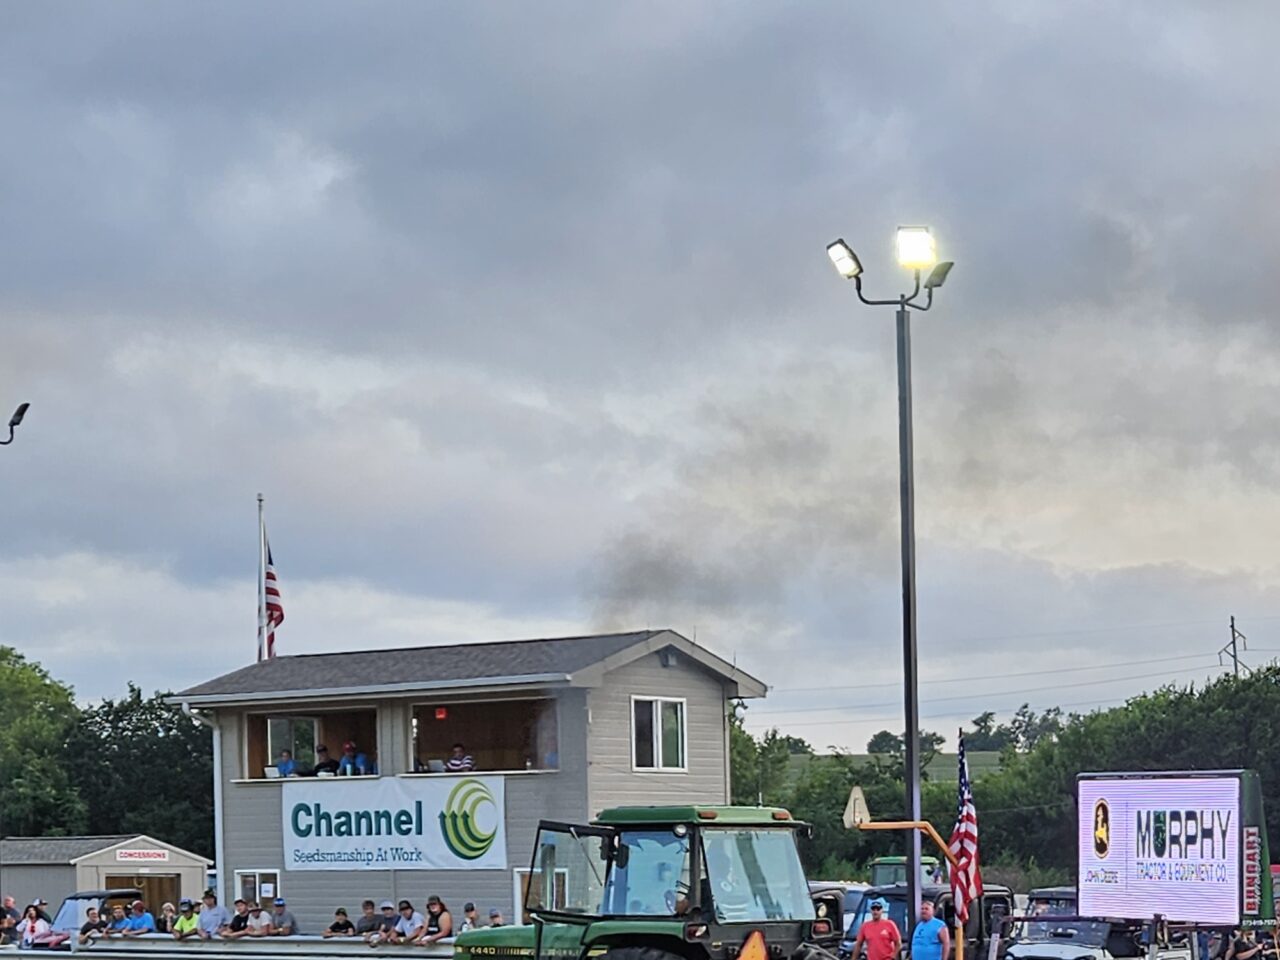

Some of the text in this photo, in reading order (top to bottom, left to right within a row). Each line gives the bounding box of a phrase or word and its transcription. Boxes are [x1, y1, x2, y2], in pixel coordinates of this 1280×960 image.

[291, 801, 423, 838] Channel
[1136, 810, 1232, 860] MURPHY
[119, 851, 166, 859] CONCESSIONS
[293, 848, 423, 866] Seedsmanship At Work
[1136, 862, 1166, 881] TRACTOR
[1174, 863, 1214, 882] EQUIPMENT
[1245, 829, 1257, 912] BUNGART
[470, 946, 496, 955] 4440
